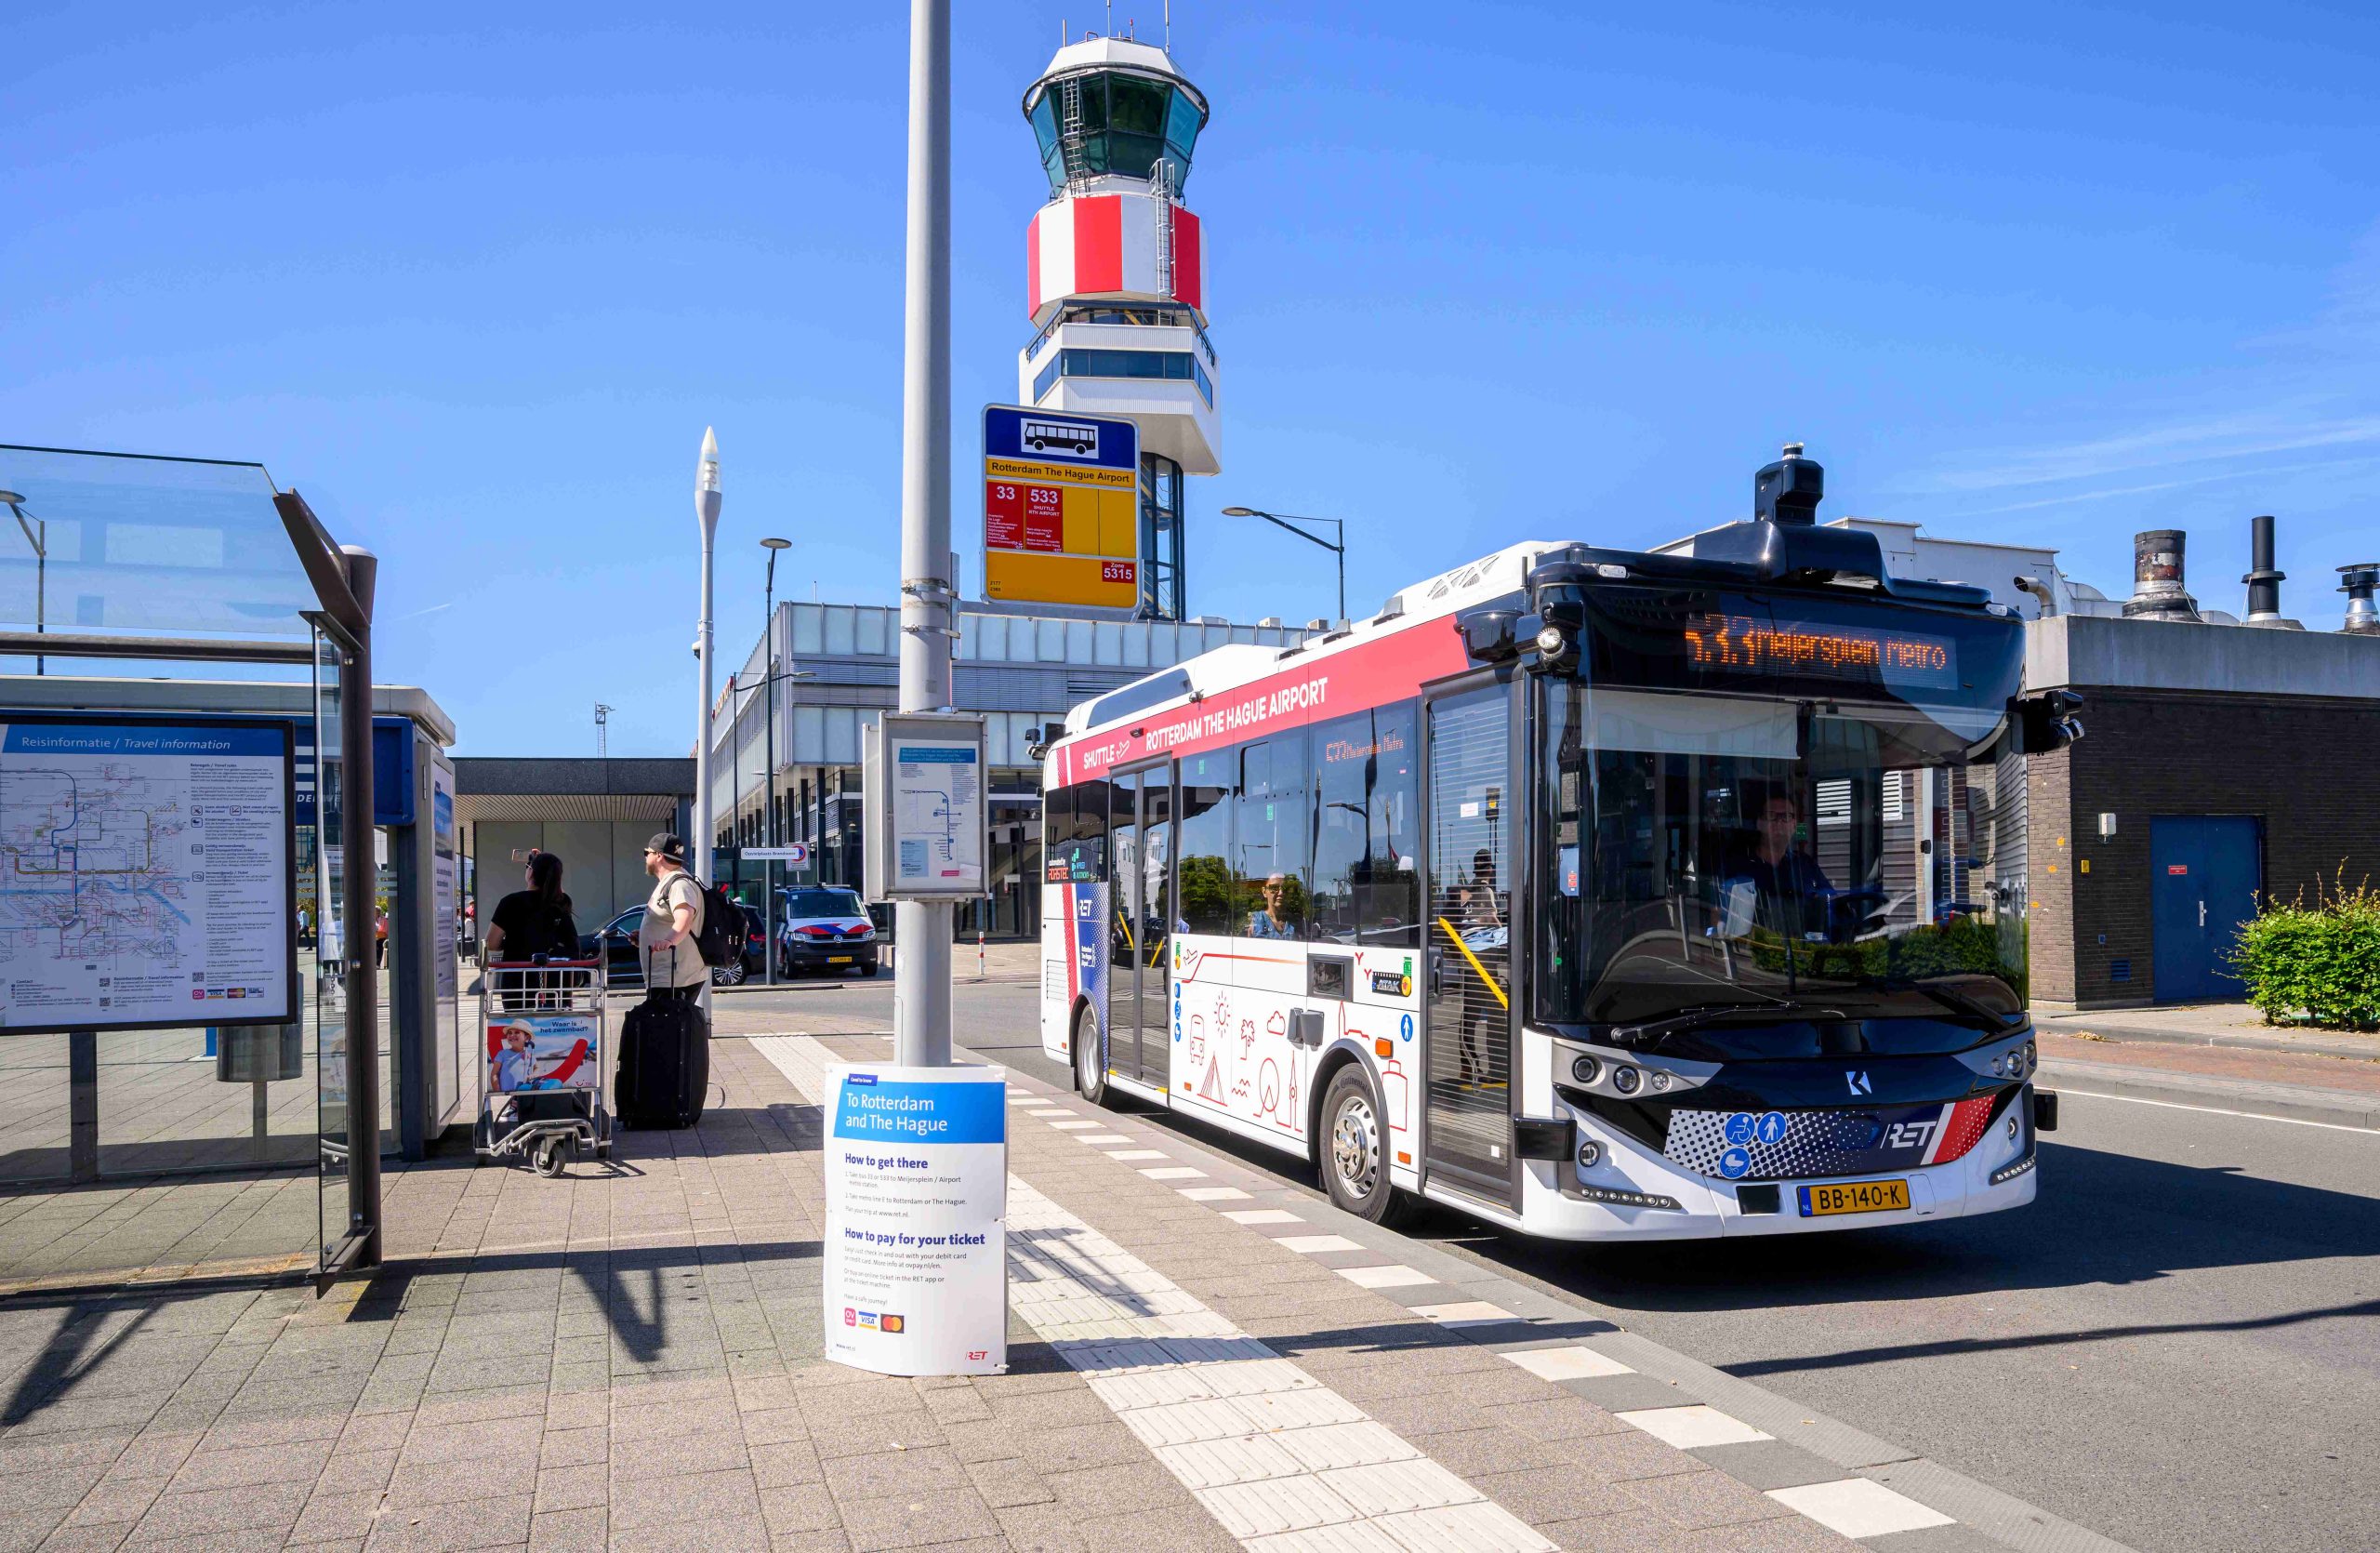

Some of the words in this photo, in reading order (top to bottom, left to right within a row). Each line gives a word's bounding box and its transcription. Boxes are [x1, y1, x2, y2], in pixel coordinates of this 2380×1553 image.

[992, 462, 1041, 475] Rotterdam
[1045, 467, 1062, 476] The
[1064, 470, 1094, 481] Hague
[1097, 471, 1130, 483] Airport
[997, 485, 1015, 500] 33
[1030, 488, 1058, 504] 533
[1104, 567, 1132, 580] 5315
[1083, 743, 1115, 770] SHUTTLE
[1146, 720, 1202, 752] ROTTERDAM
[1203, 710, 1224, 737] THE
[1226, 697, 1267, 730] HAGUE
[1268, 677, 1329, 716] AIRPORT
[22, 737, 111, 748] Reisinformatie
[114, 738, 120, 749] /
[125, 738, 159, 749] Travel
[161, 738, 231, 750] information
[847, 1093, 858, 1107] To
[862, 1095, 933, 1110] Rotterdam
[846, 1113, 866, 1128] and
[869, 1115, 892, 1129] The
[897, 1117, 947, 1135] Hague
[1884, 1121, 1937, 1148] RET
[845, 1153, 864, 1165] How
[866, 1155, 875, 1166] to
[878, 1157, 894, 1170] get
[897, 1157, 929, 1169] there
[897, 1175, 933, 1184] Meijersplein
[939, 1176, 961, 1185] Airport
[893, 1197, 923, 1205] Rotterdam
[1819, 1186, 1901, 1210] BB-140-K
[845, 1228, 864, 1240] How
[866, 1230, 875, 1241] to
[878, 1234, 896, 1247] pay
[899, 1233, 916, 1244] for
[918, 1236, 946, 1248] your
[949, 1233, 985, 1245] ticket
[906, 1262, 943, 1270] ovpay.nl/en.
[846, 1310, 855, 1319] OV
[861, 1316, 875, 1325] VISA
[836, 1343, 856, 1351] www.ret.nl
[966, 1351, 988, 1361] RET
